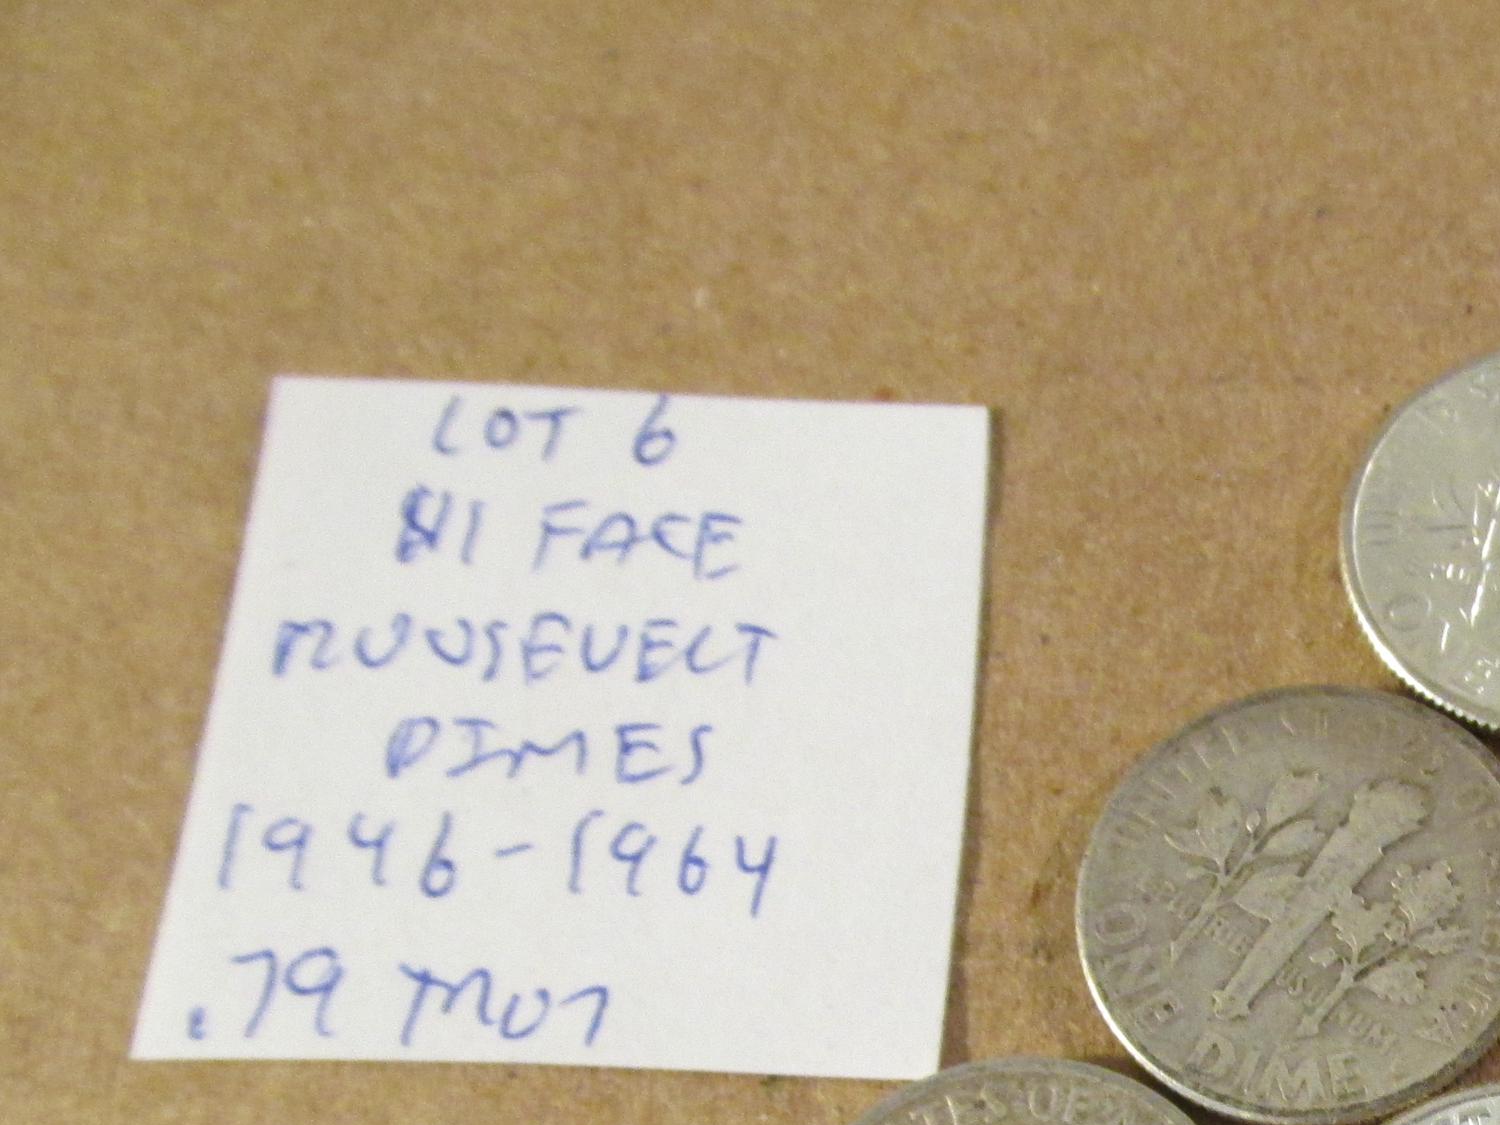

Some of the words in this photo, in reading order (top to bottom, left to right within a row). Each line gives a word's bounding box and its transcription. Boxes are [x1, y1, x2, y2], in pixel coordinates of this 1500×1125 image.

[432, 395, 582, 460] LOT
[632, 394, 678, 467] 6
[531, 499, 743, 580] FACE
[385, 716, 715, 786] DIMES
